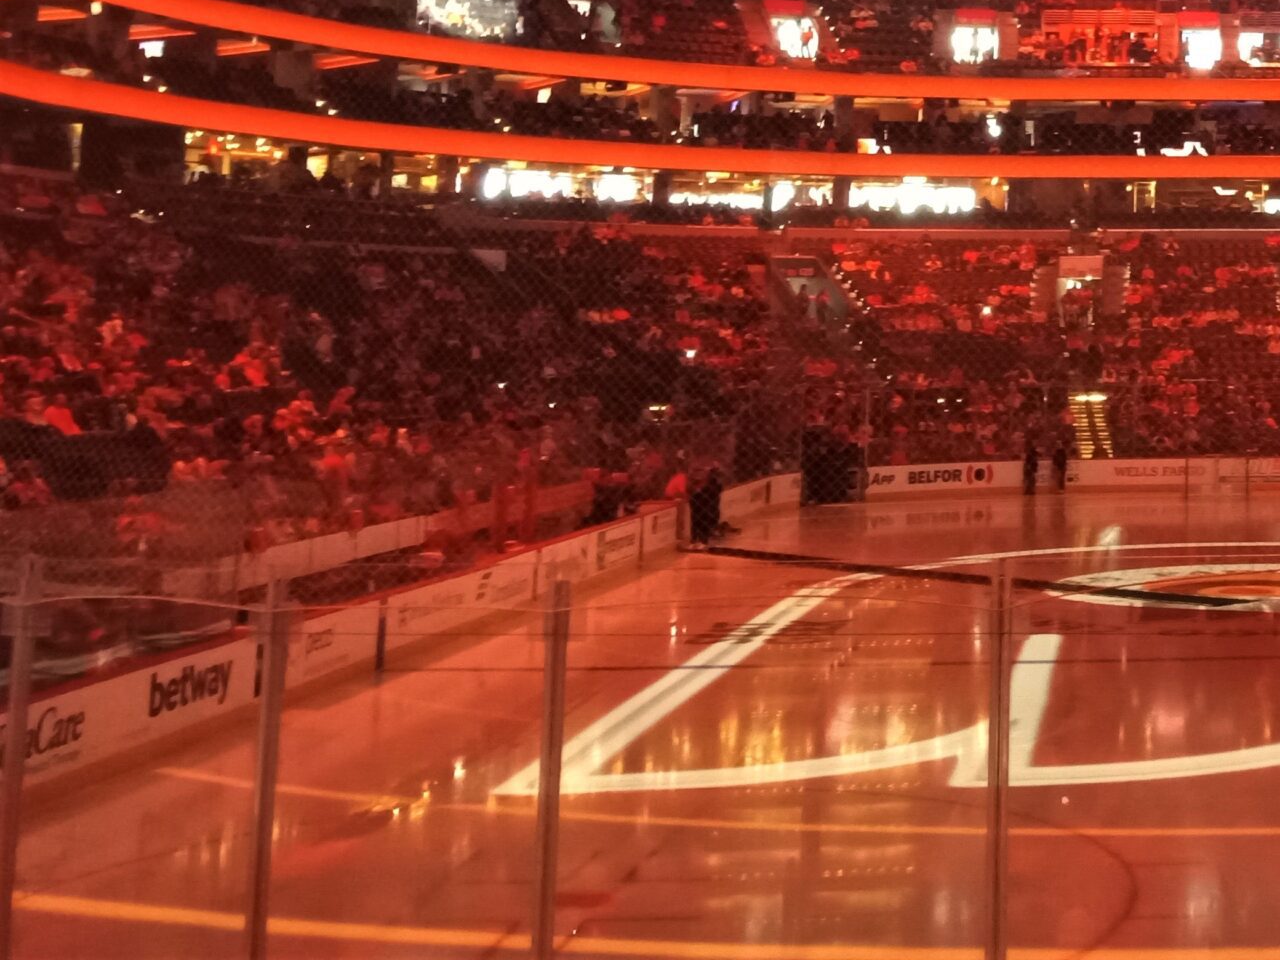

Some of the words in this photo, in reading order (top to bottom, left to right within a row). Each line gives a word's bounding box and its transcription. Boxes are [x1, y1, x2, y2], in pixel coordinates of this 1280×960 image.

[907, 469, 962, 485] BELFOR
[1113, 466, 1159, 477] WELLS
[148, 660, 233, 718] betway
